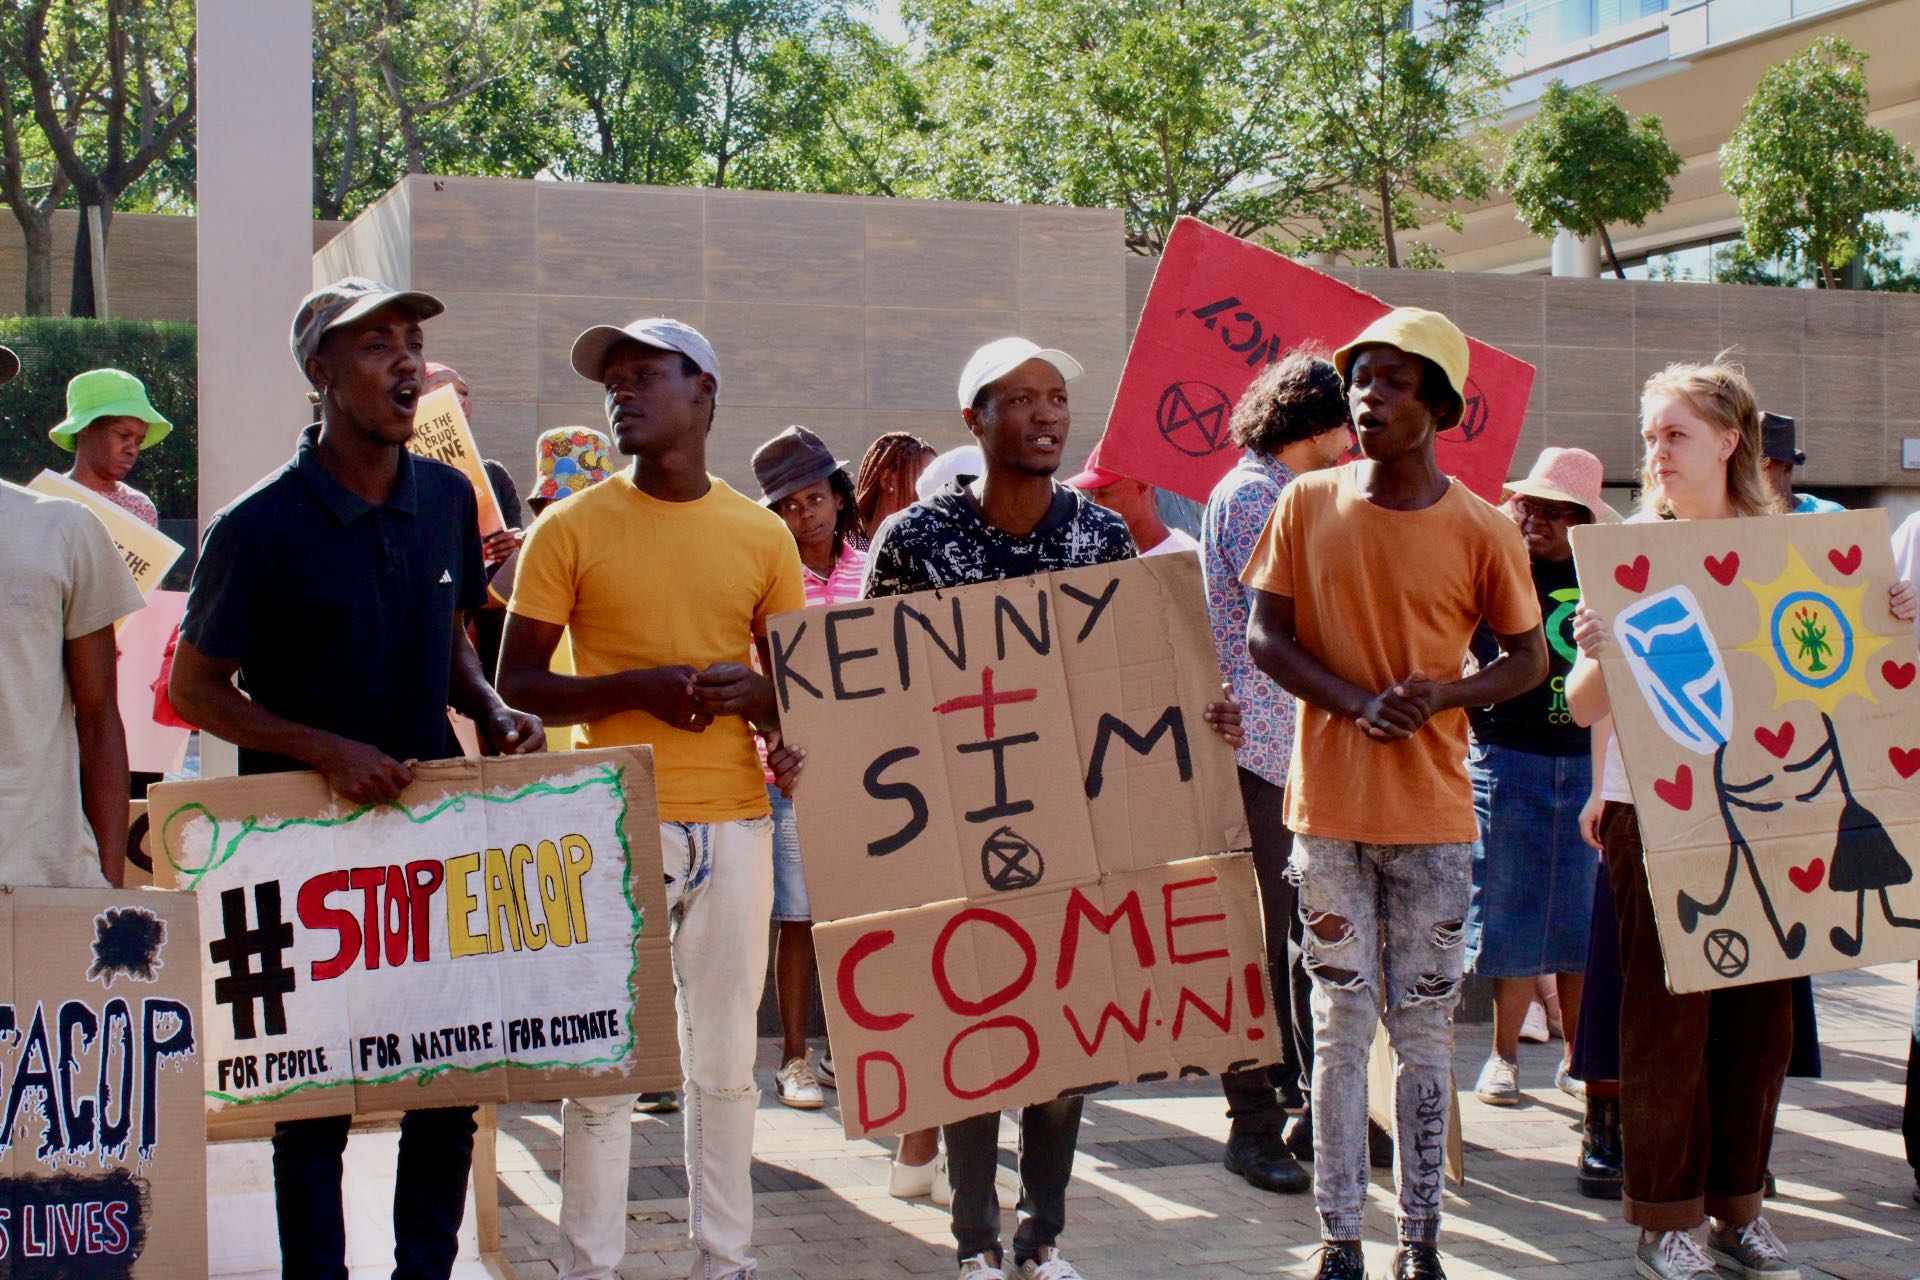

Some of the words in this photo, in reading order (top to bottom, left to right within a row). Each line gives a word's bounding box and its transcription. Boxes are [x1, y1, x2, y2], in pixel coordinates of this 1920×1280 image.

[425, 425, 457, 450] CRUDE
[432, 412, 453, 429] THE
[125, 551, 151, 576] THE
[770, 579, 1119, 713] KENNY
[863, 706, 1192, 857] SIM
[210, 834, 593, 1040] #STOPEACOP
[838, 876, 1230, 1031] COME
[0, 999, 195, 1160] ACOP
[218, 1056, 259, 1092] FOR
[360, 1038, 401, 1072] FOR
[509, 1015, 546, 1053] FOR
[1410, 1075, 1444, 1209] KULTURE
[24, 1201, 129, 1257] LIVES
